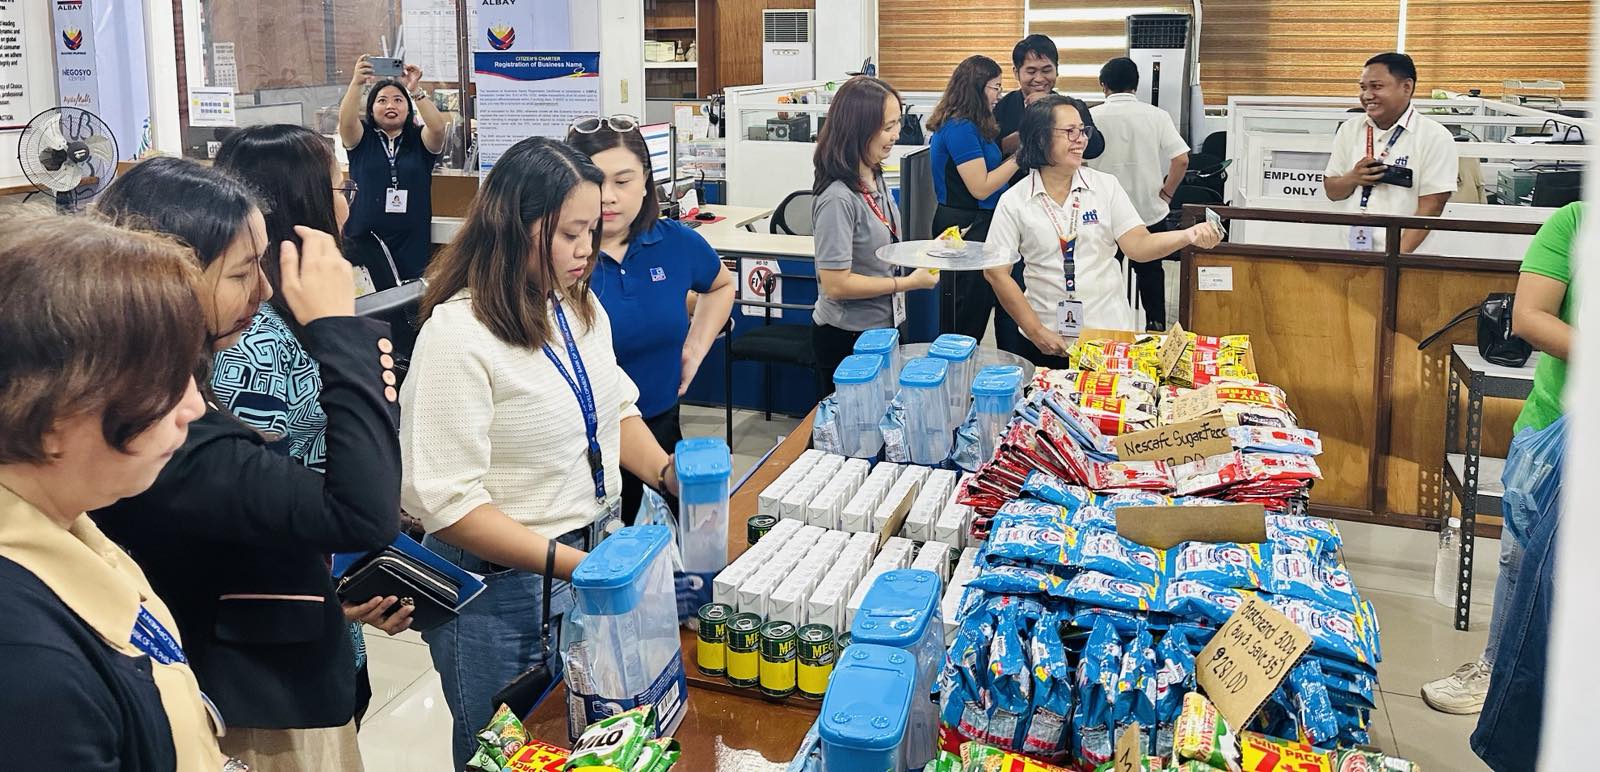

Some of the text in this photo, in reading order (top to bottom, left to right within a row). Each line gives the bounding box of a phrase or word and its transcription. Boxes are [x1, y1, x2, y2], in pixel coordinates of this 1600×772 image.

[1264, 171, 1325, 182] EMPLOYE
[1283, 186, 1318, 196] ONLY
[1082, 209, 1098, 221] dti
[580, 374, 593, 410] DEVELOPMENT
[1124, 432, 1173, 456] Nescafe
[1248, 640, 1268, 666] Save
[571, 729, 623, 754] MILO
[1247, 737, 1323, 764] TWIN PACK
